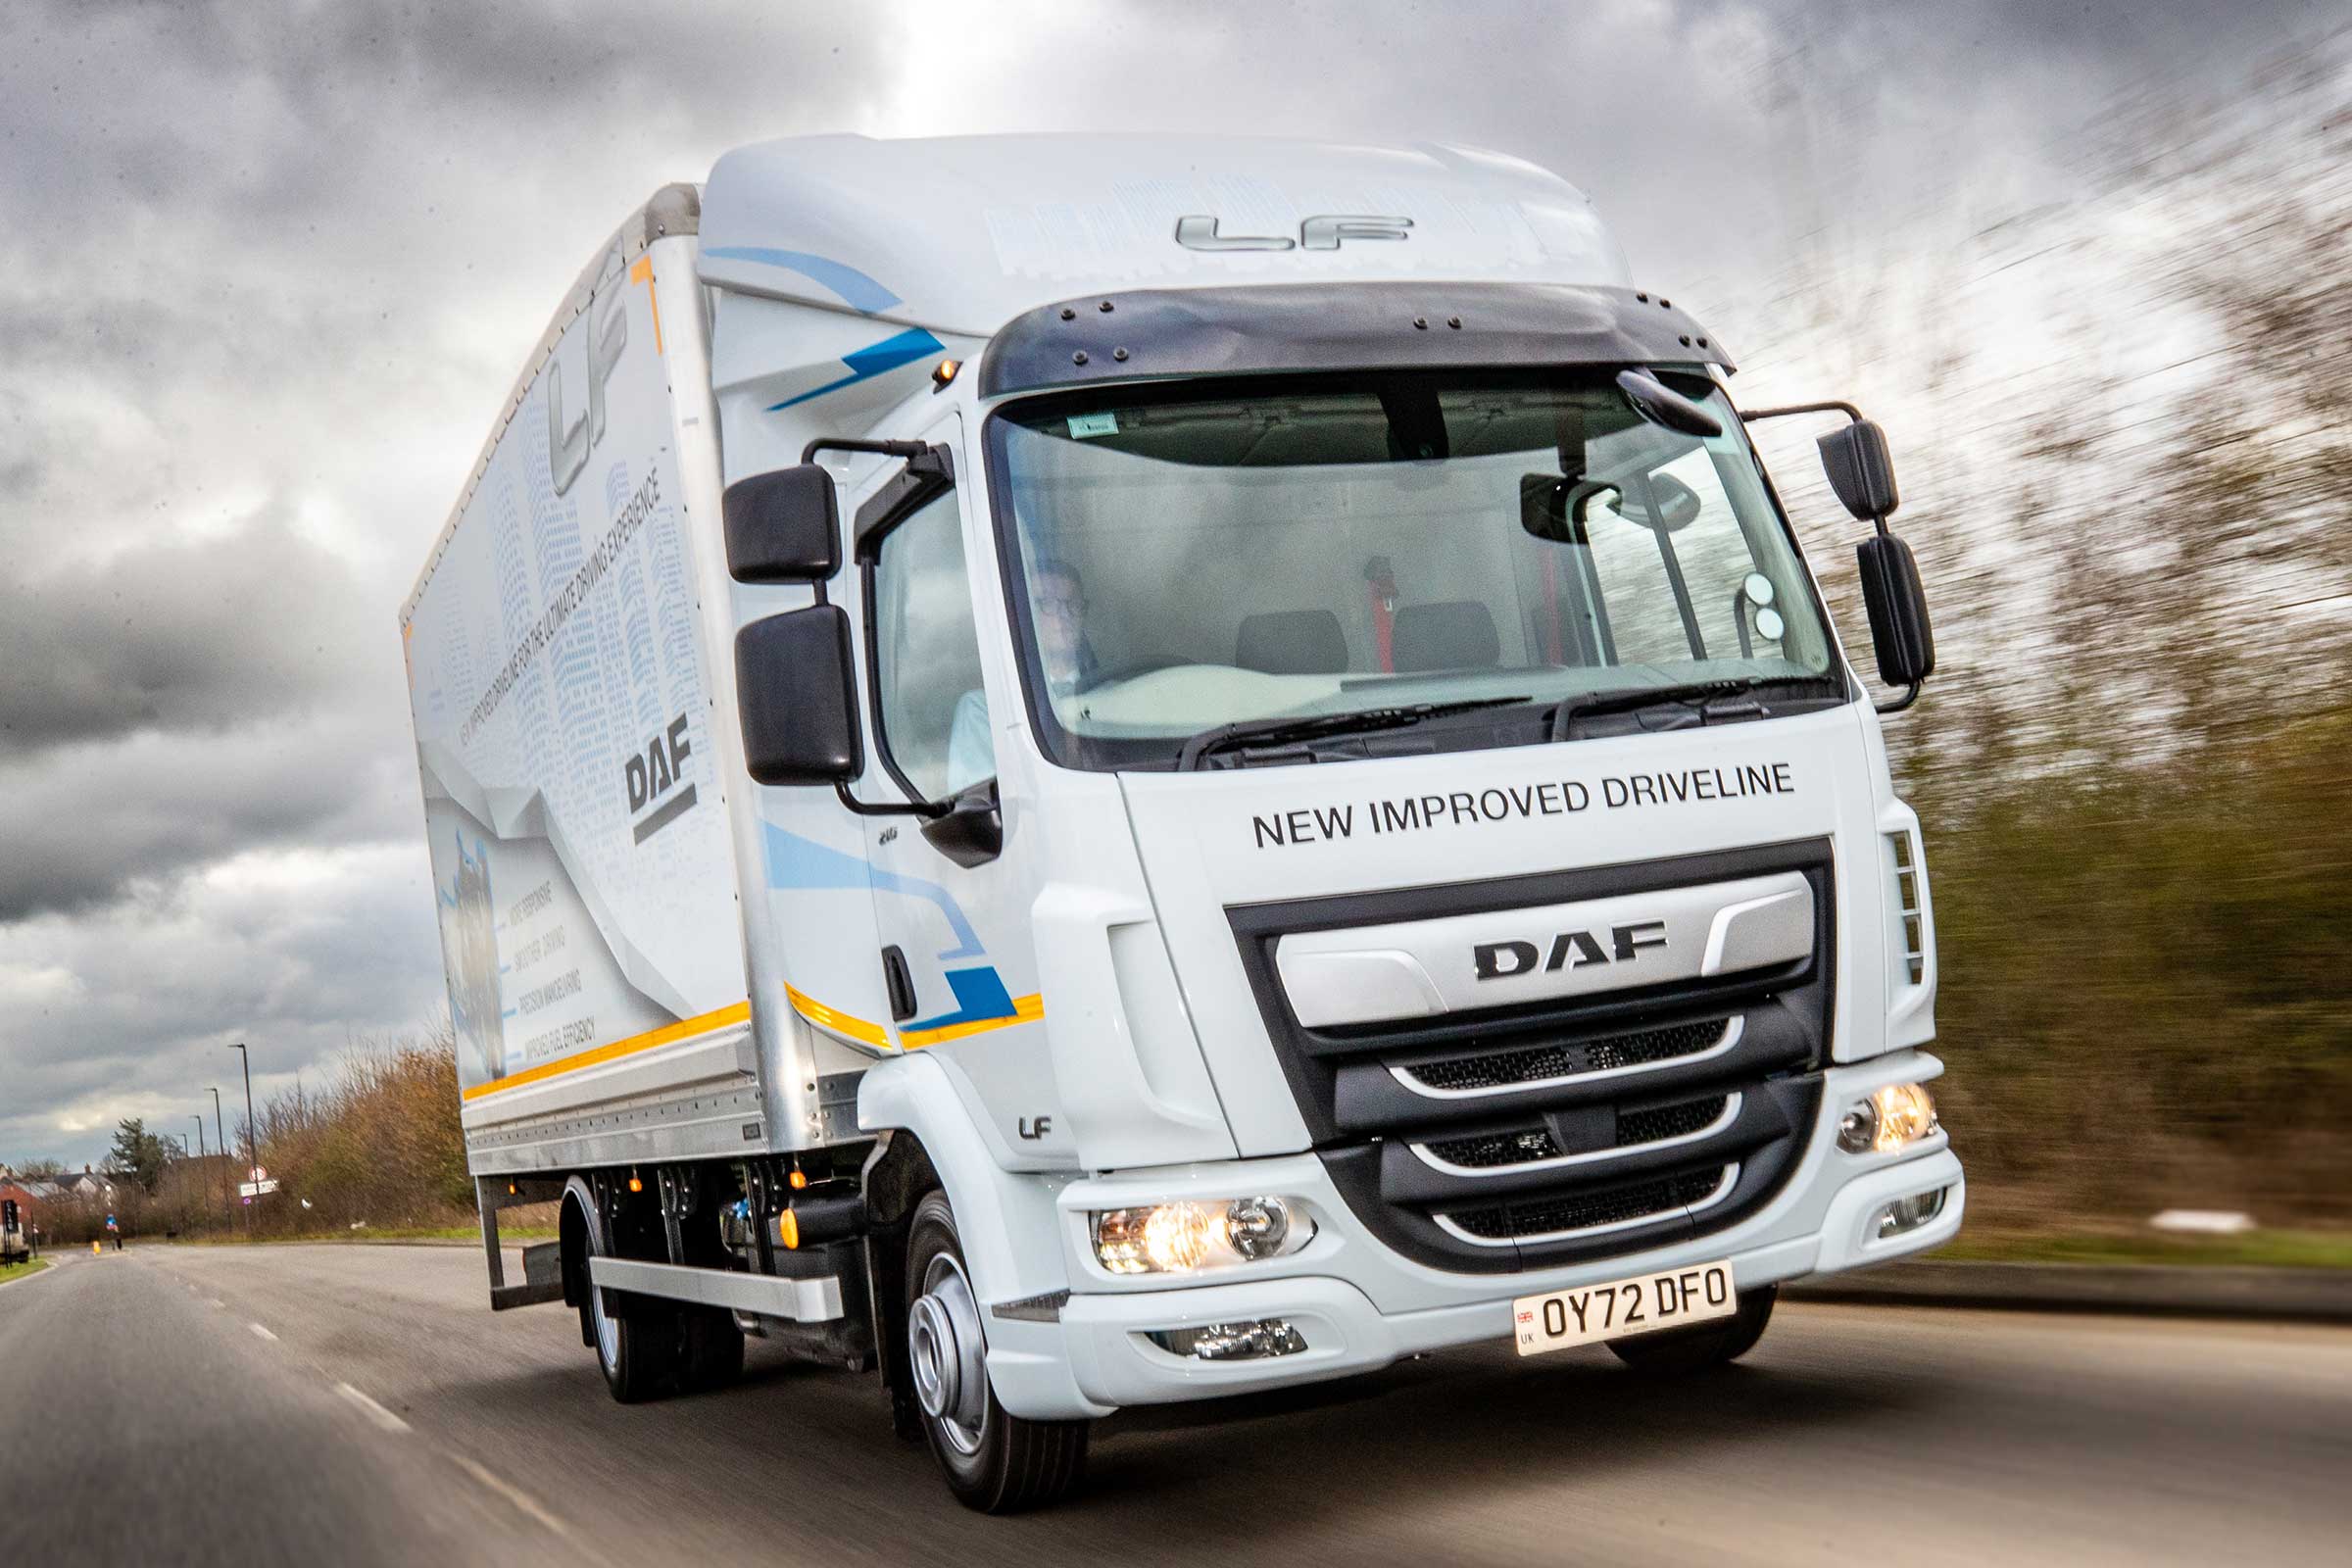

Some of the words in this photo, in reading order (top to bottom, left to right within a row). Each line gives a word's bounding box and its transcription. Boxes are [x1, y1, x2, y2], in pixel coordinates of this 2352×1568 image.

[1175, 214, 1415, 252] LF
[548, 233, 627, 497] LF
[530, 620, 545, 658] THE
[542, 580, 576, 641] ULTIMATE
[575, 540, 608, 603] DRIVING
[607, 466, 661, 563] EXPERIENCE
[625, 712, 692, 814] DAF
[1252, 806, 1353, 850] NEW
[1370, 781, 1591, 834] IMPROVED
[1603, 762, 1795, 808] DRIVELINE
[1473, 919, 1669, 981] DAF
[563, 1014, 596, 1049] EFFICIENCY
[1018, 1114, 1053, 1141] LF
[1543, 1283, 1645, 1340] OY72
[1654, 1267, 1728, 1318] DFO
[1520, 1333, 1535, 1346] UK
